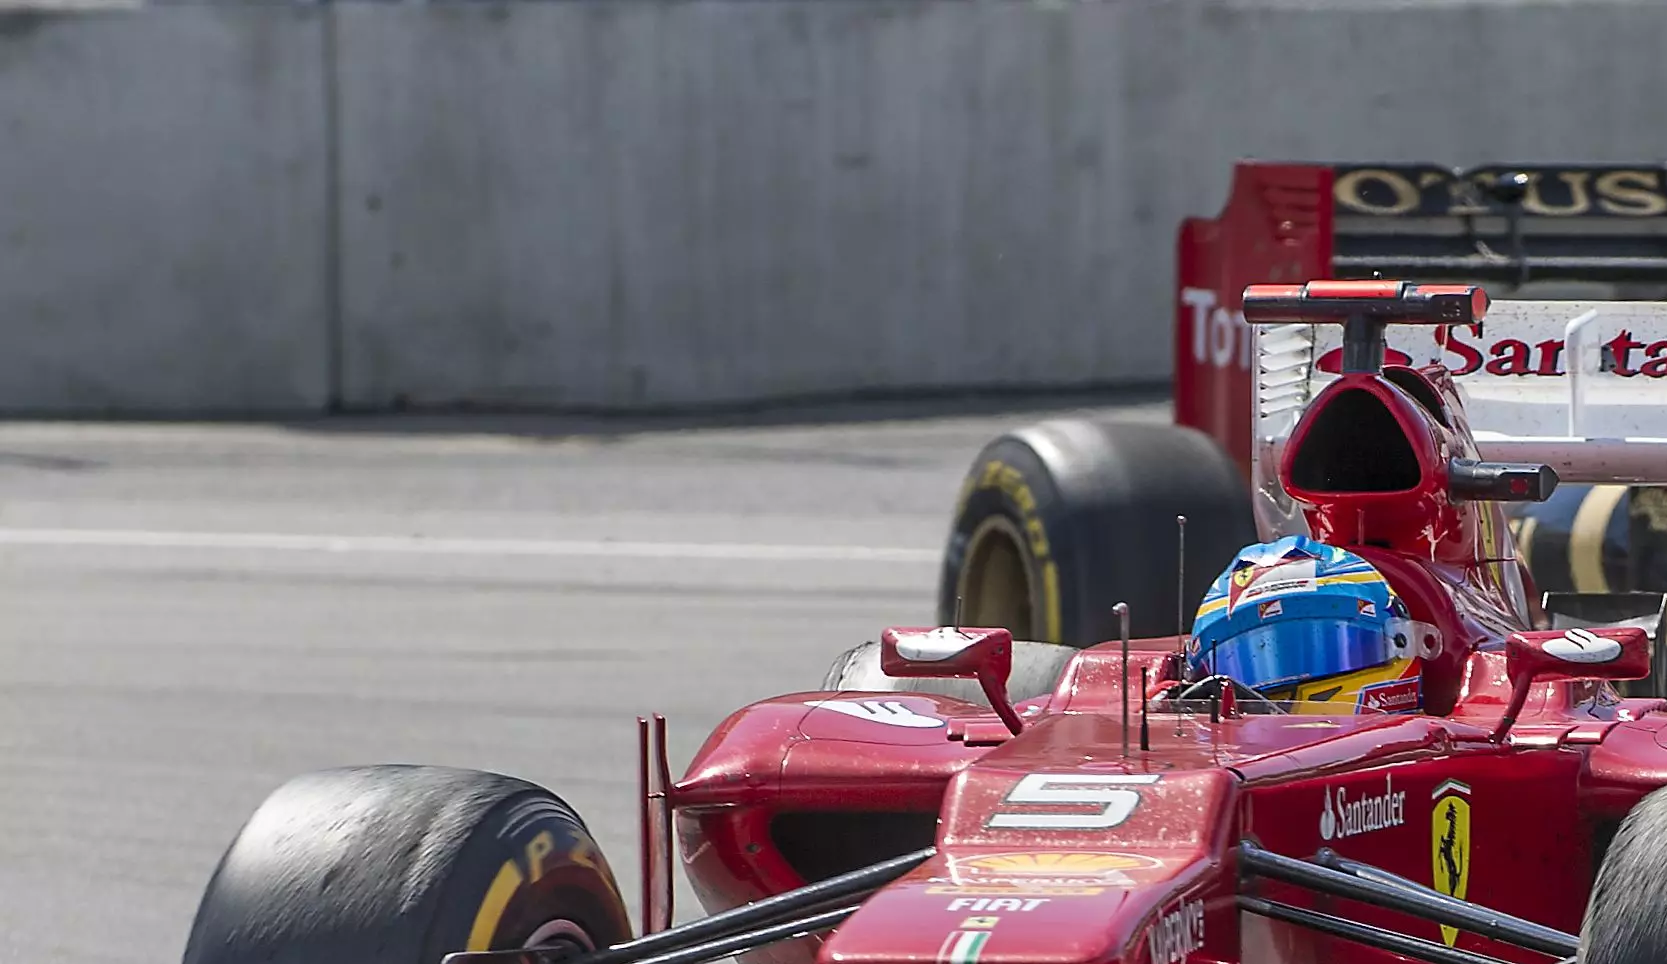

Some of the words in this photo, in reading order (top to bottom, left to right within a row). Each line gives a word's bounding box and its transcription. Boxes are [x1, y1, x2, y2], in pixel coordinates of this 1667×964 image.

[986, 773, 1161, 829] 5
[1336, 773, 1406, 839] Santander
[947, 898, 1050, 912] FIAT
